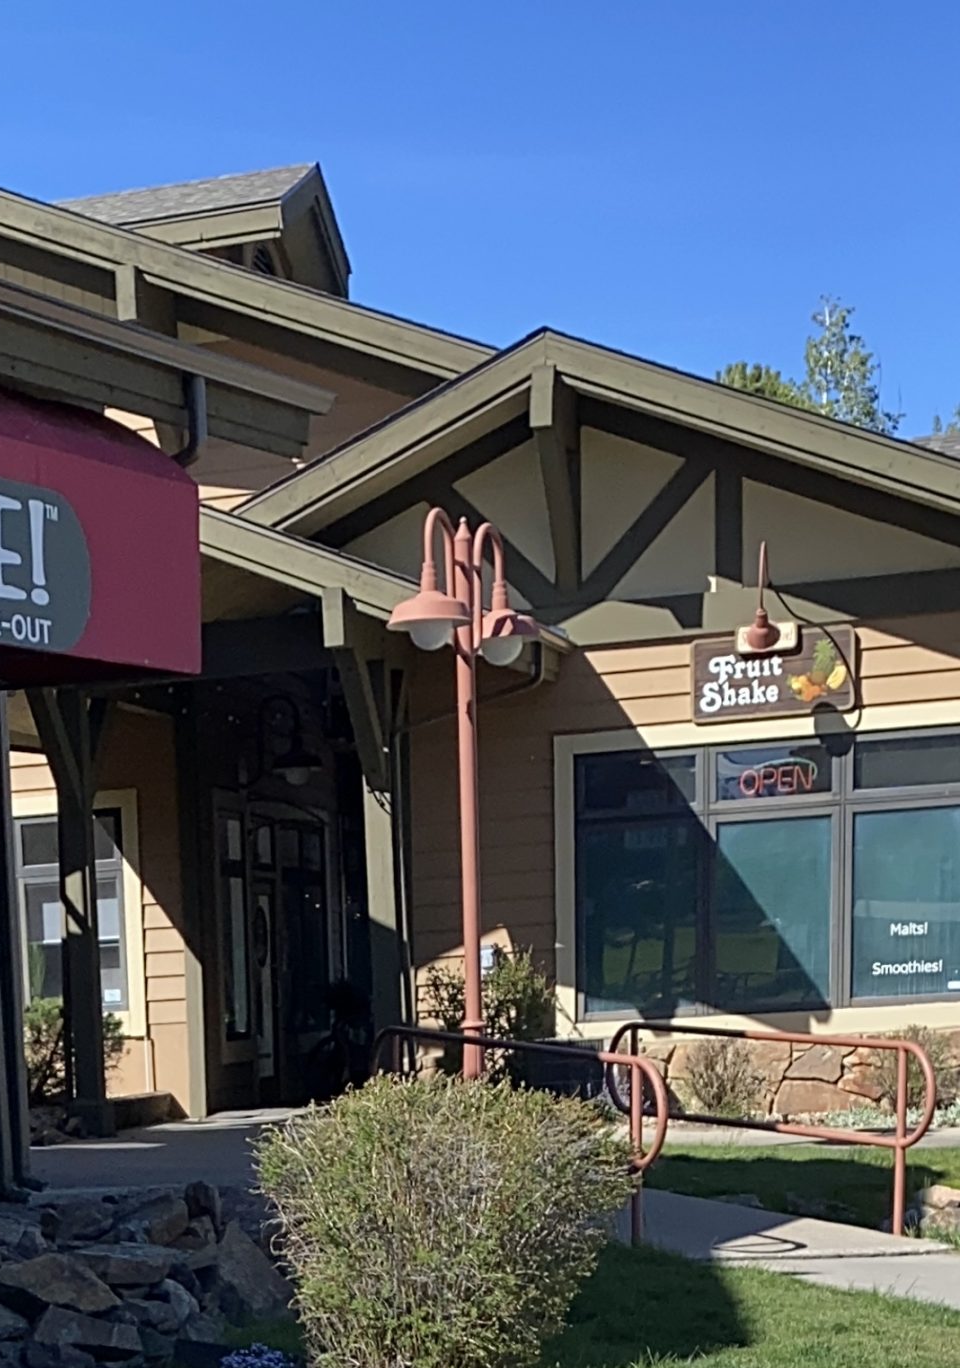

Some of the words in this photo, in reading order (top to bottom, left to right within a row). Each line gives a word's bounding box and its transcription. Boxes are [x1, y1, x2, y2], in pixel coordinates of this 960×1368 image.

[45, 504, 58, 521] TM
[709, 654, 784, 686] Fruit
[699, 679, 780, 713] Shake
[740, 765, 814, 796] OPEN
[889, 921, 929, 936] Malts!
[871, 958, 944, 976] Smoothies!
